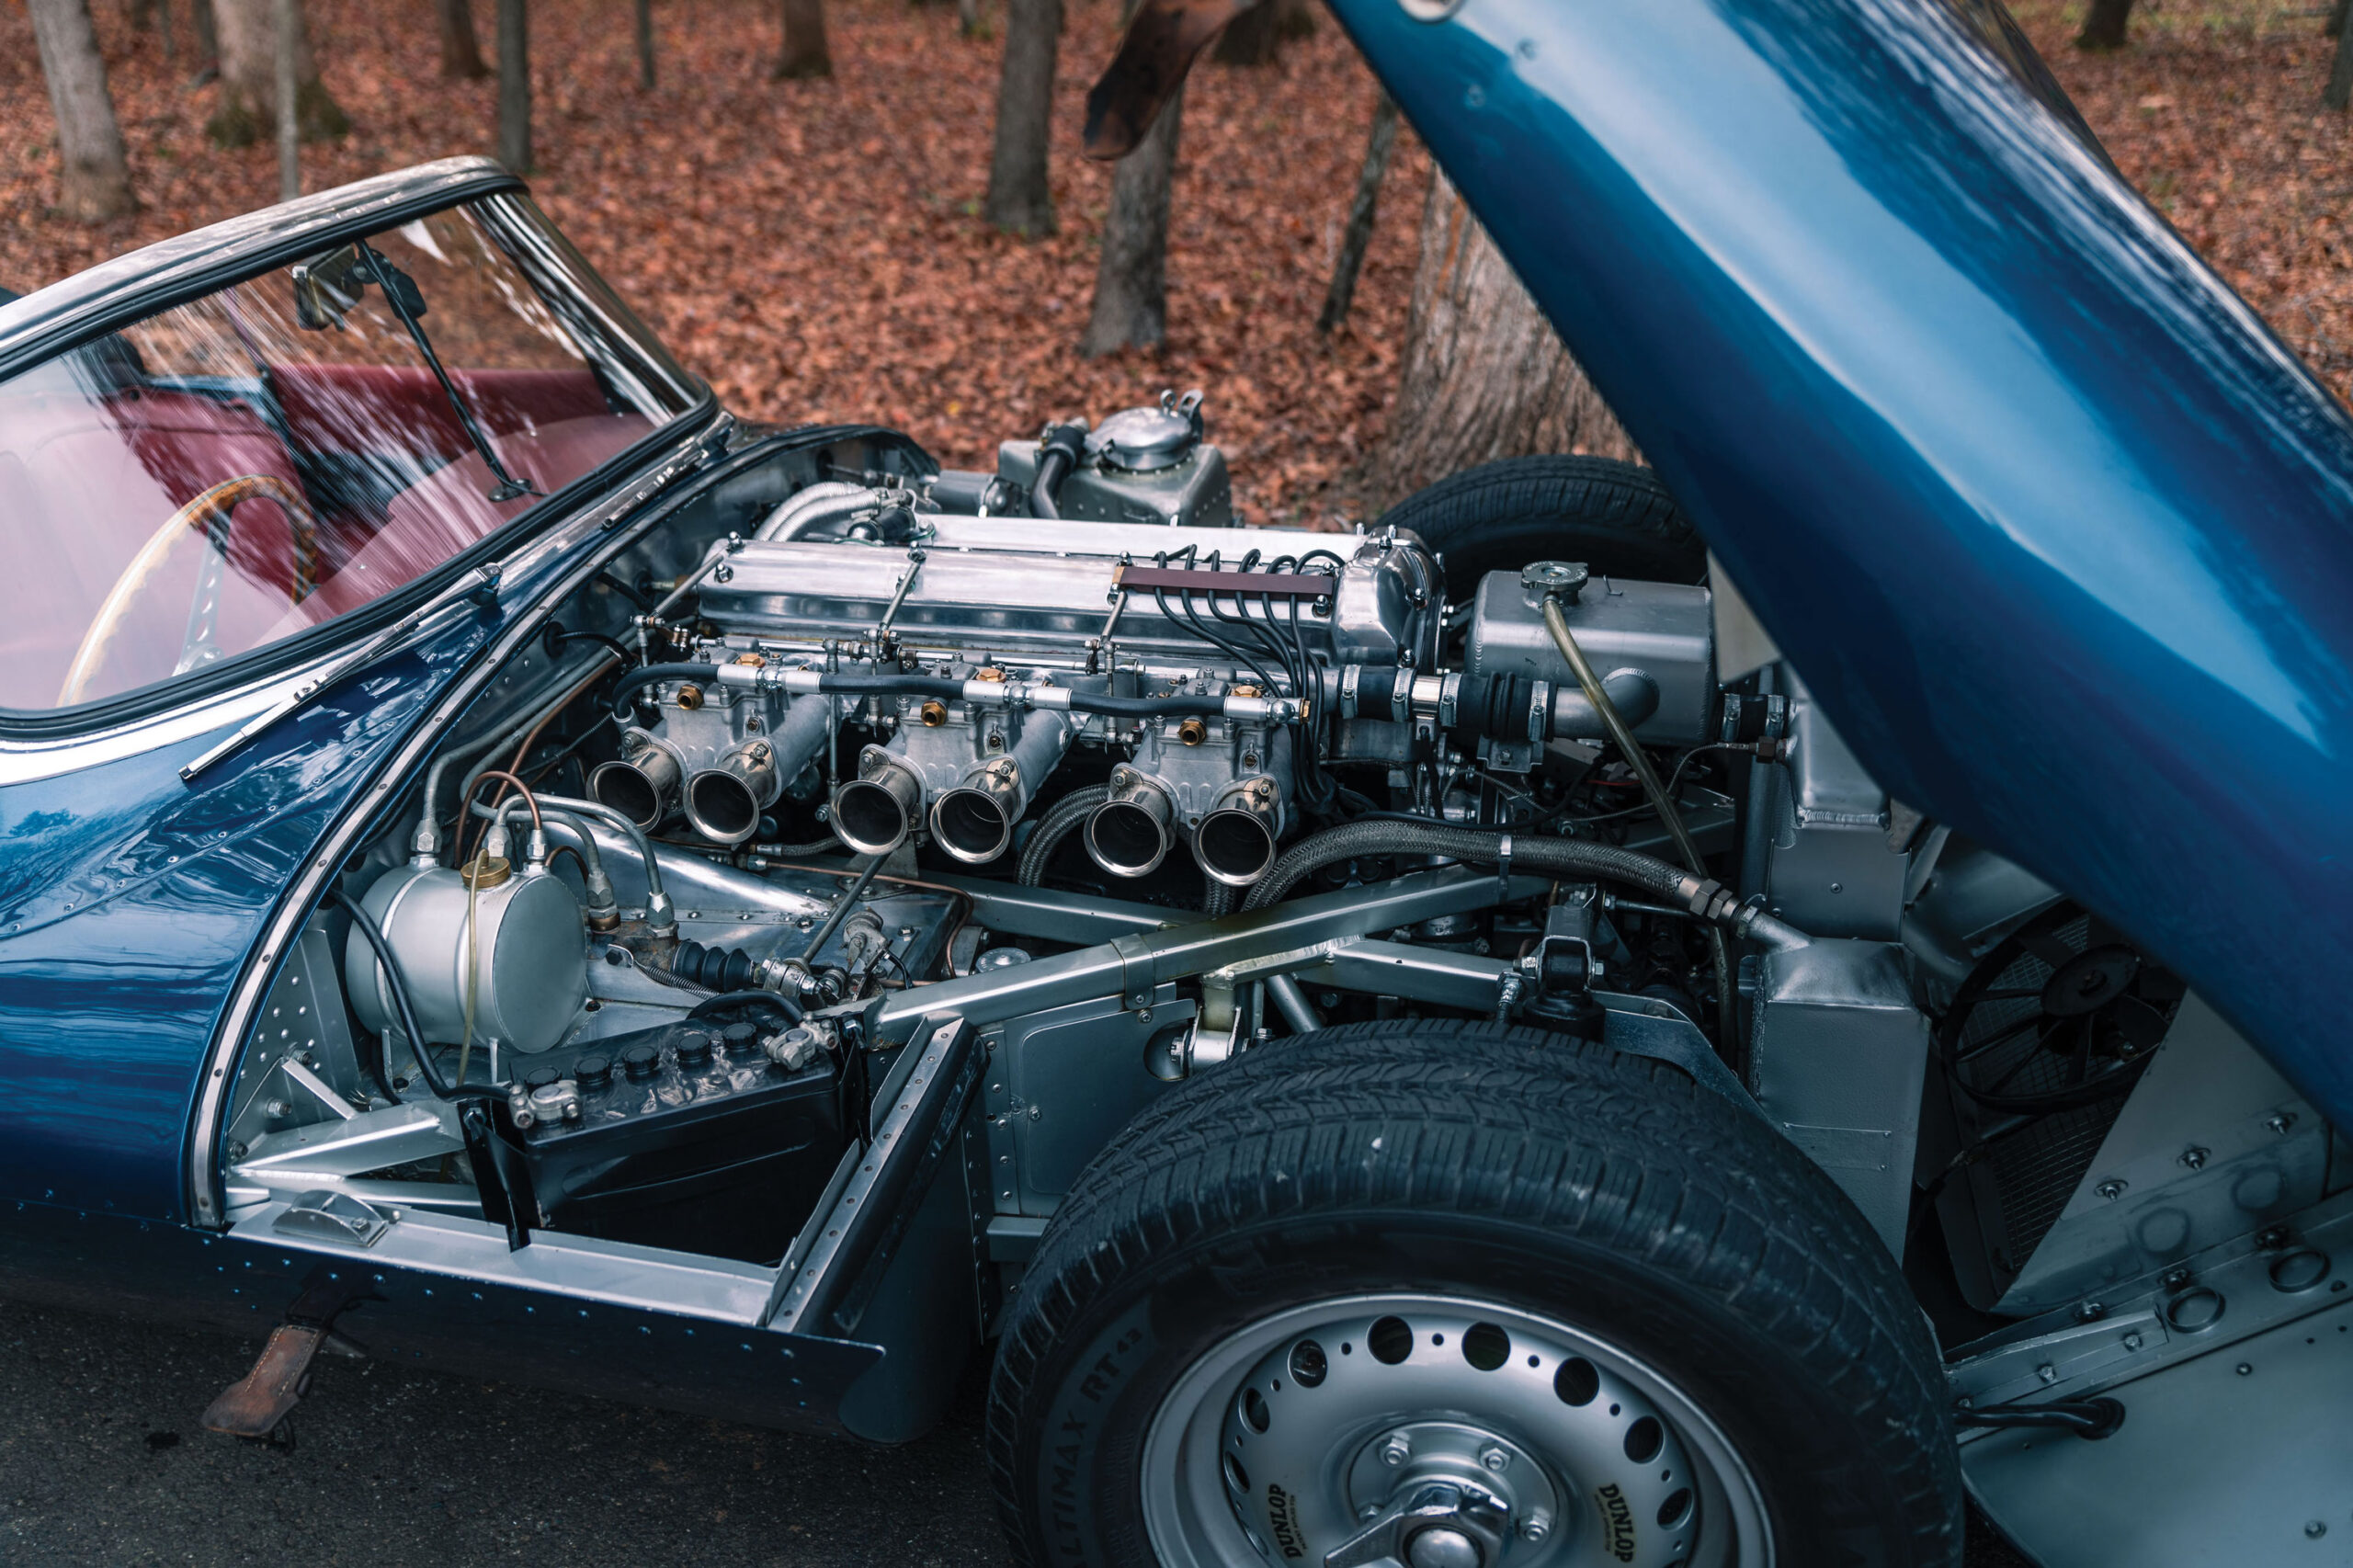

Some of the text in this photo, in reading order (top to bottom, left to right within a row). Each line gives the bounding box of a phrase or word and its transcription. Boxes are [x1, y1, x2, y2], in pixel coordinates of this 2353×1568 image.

[1051, 1409, 1089, 1568] LTIMAX
[1268, 1483, 1303, 1559] DUNLOP
[1599, 1483, 1634, 1562] DUNLOP
